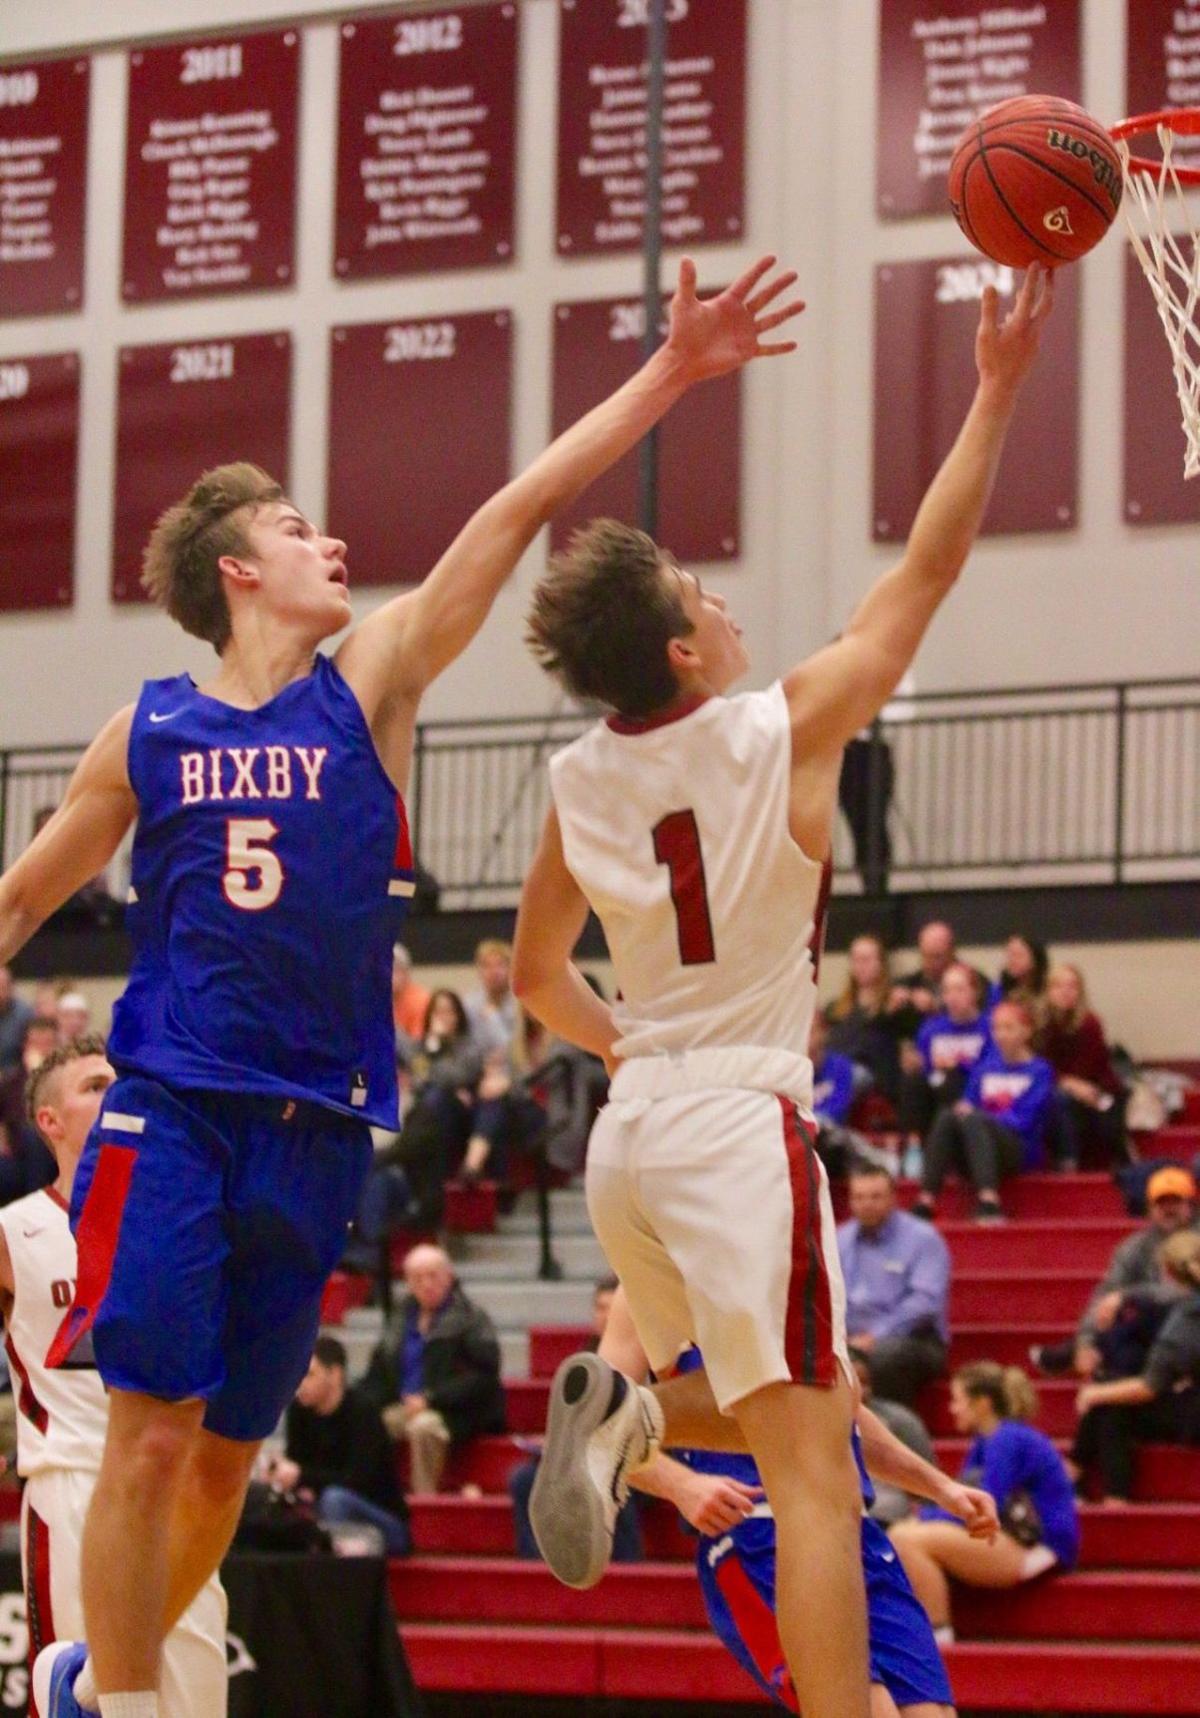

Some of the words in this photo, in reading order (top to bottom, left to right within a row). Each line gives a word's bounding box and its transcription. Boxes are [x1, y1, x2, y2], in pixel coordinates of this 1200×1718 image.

[617, 0, 689, 26] 203
[393, 15, 462, 55] 2012
[180, 43, 243, 84] 2011
[384, 322, 456, 362] 2022
[170, 344, 235, 382] 2021
[180, 745, 328, 805] BIXBY
[222, 816, 286, 912] 5
[652, 808, 716, 966] 1
